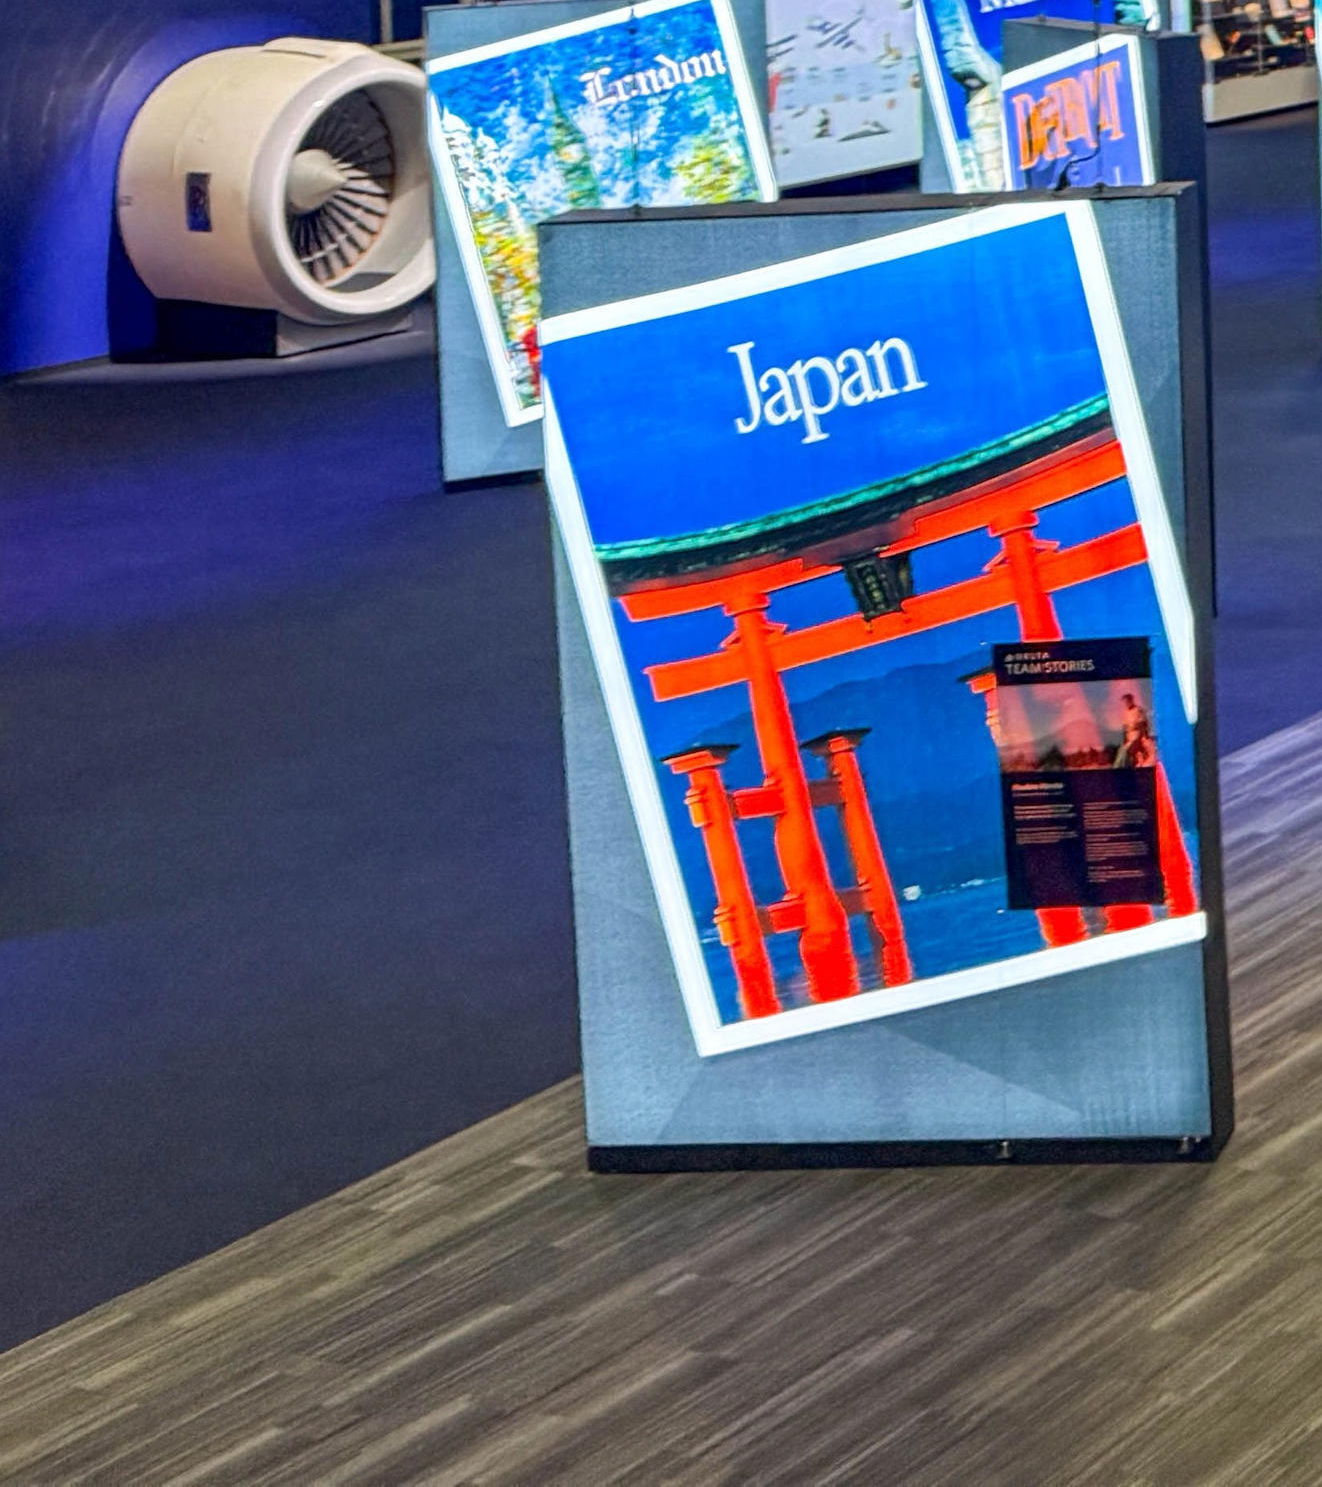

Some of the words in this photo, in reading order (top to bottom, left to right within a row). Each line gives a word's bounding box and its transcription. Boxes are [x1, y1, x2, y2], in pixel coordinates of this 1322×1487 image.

[577, 50, 727, 106] London
[727, 336, 927, 445] Japan
[1005, 663, 1042, 675] TEAM
[1044, 659, 1095, 673] STORIES
